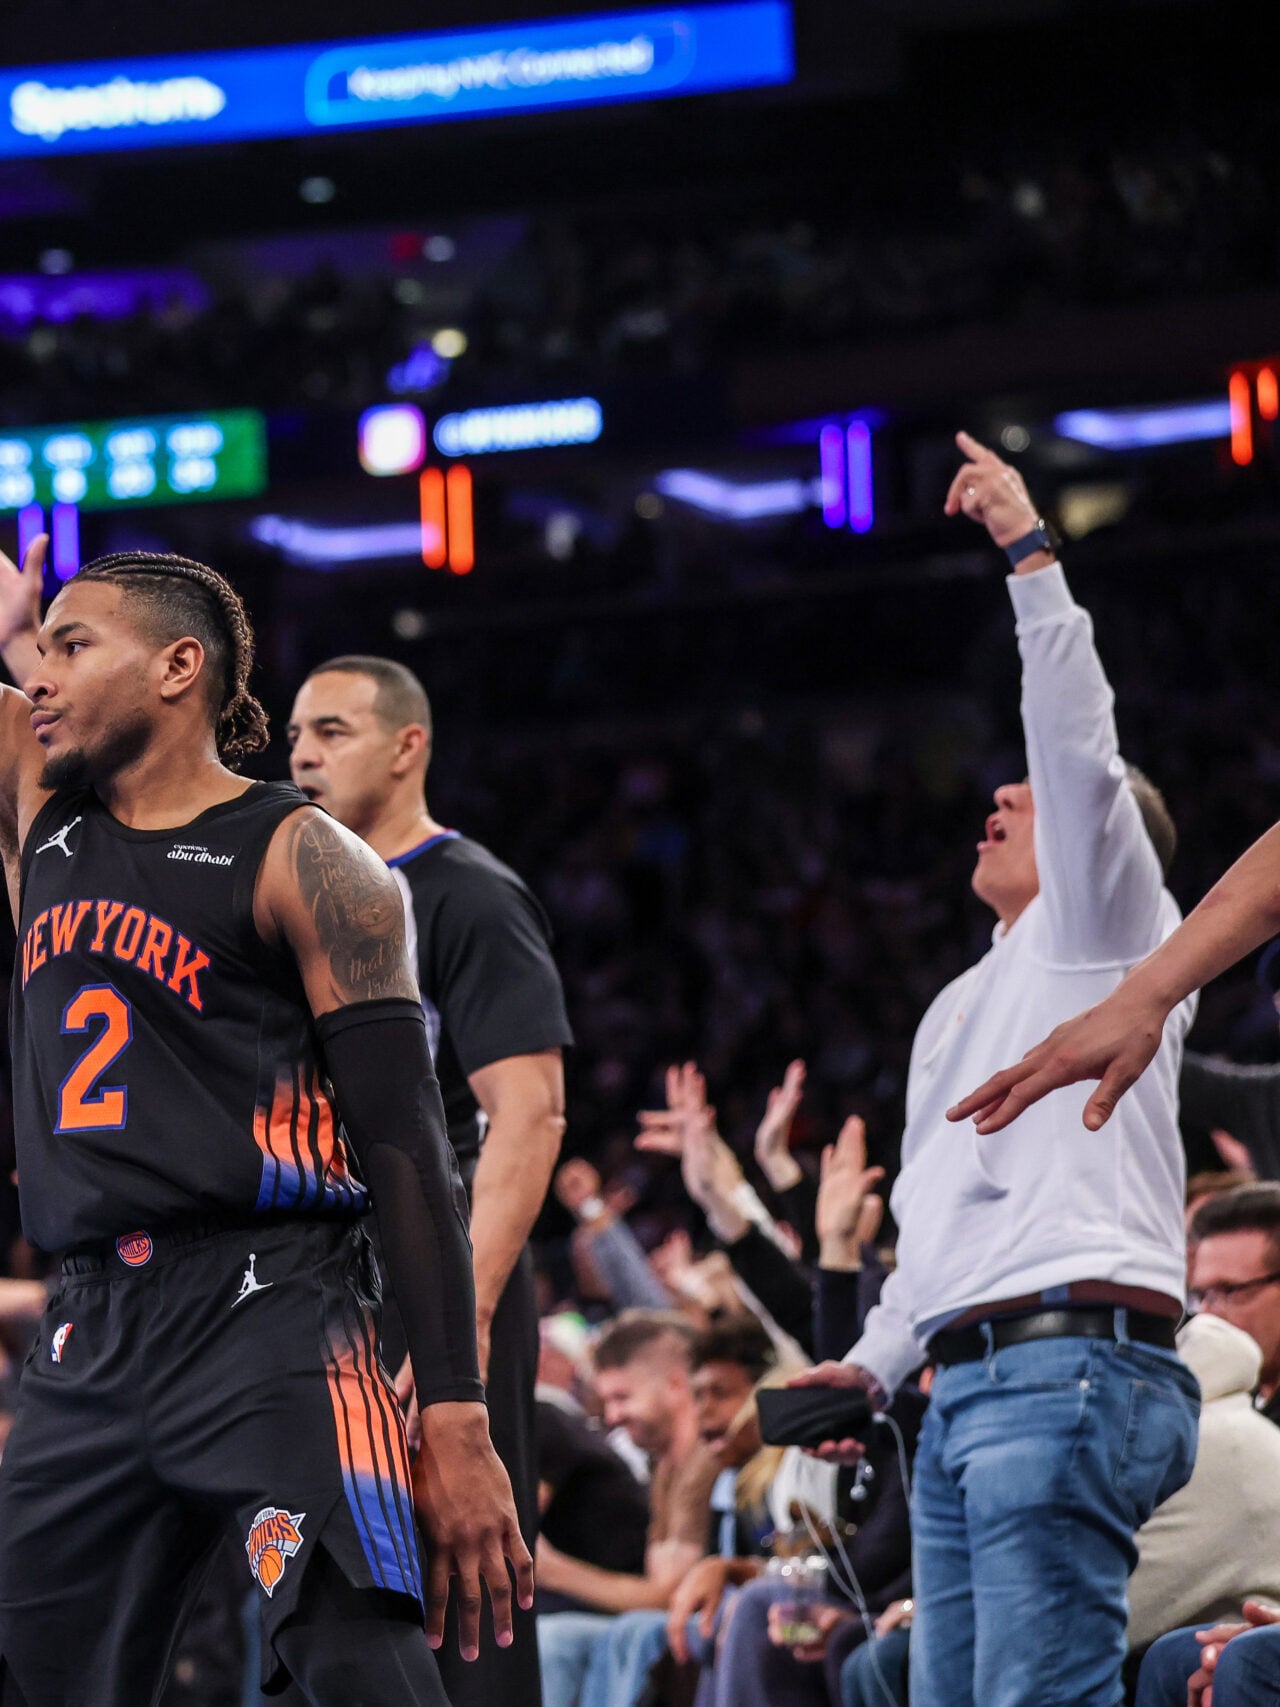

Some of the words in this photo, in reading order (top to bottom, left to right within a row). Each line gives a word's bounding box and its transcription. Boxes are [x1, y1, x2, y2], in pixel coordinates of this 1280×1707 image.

[166, 849, 193, 862] abu
[194, 852, 235, 866] dhabi
[21, 899, 94, 992] NEW
[89, 899, 212, 1014] YORK
[53, 982, 134, 1135] 2
[249, 1513, 300, 1564] KNICKS
